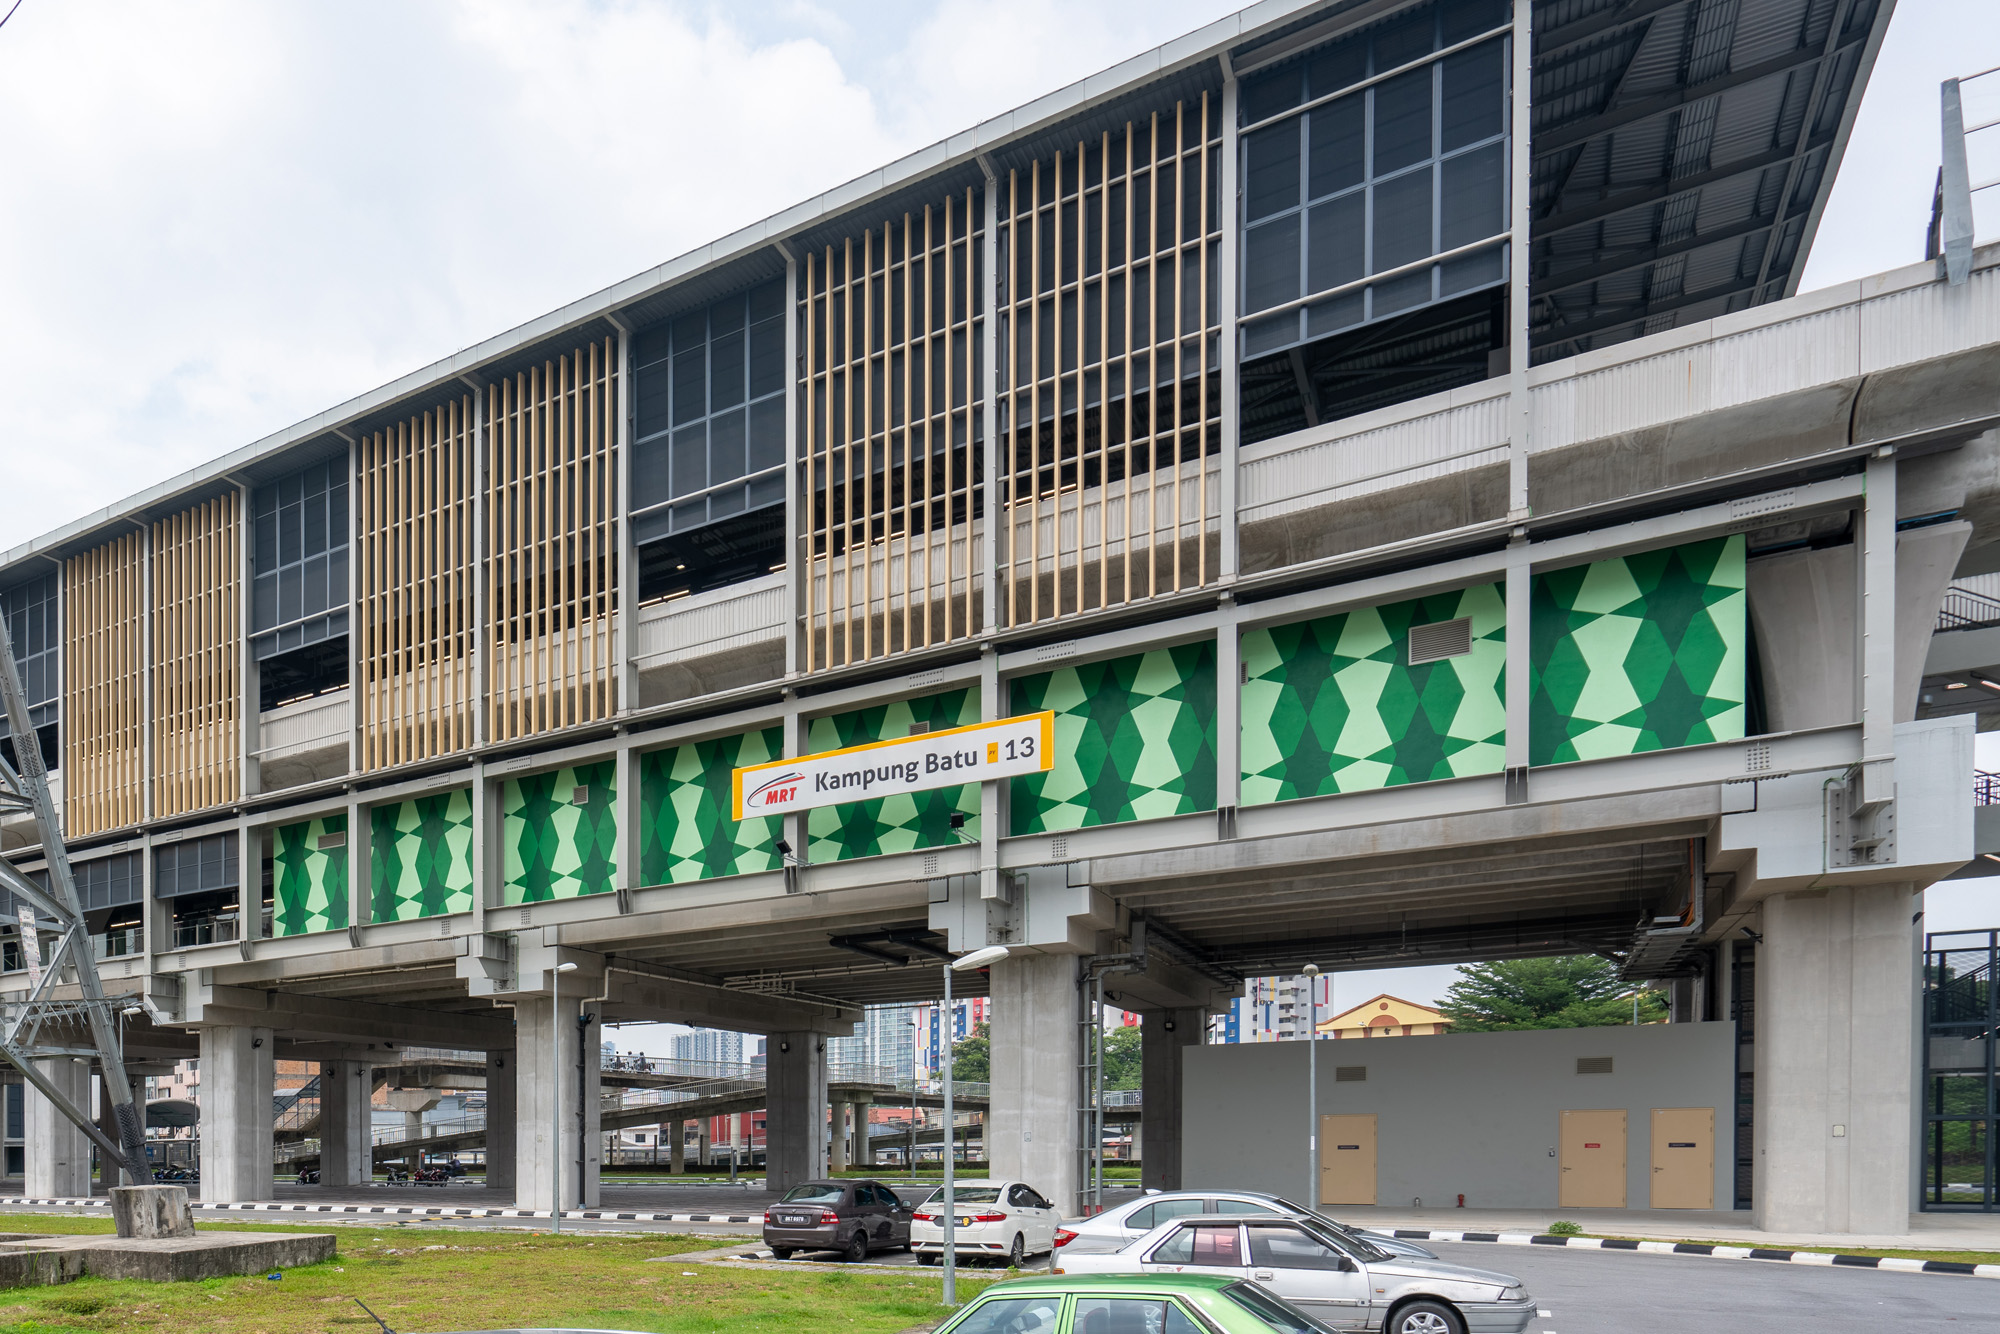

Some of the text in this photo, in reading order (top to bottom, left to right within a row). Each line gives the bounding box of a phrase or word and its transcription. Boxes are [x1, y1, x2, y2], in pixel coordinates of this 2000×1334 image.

[815, 761, 919, 792] Kampung
[925, 750, 977, 773] Batu
[1005, 736, 1035, 760] 13
[765, 787, 797, 805] MRT
